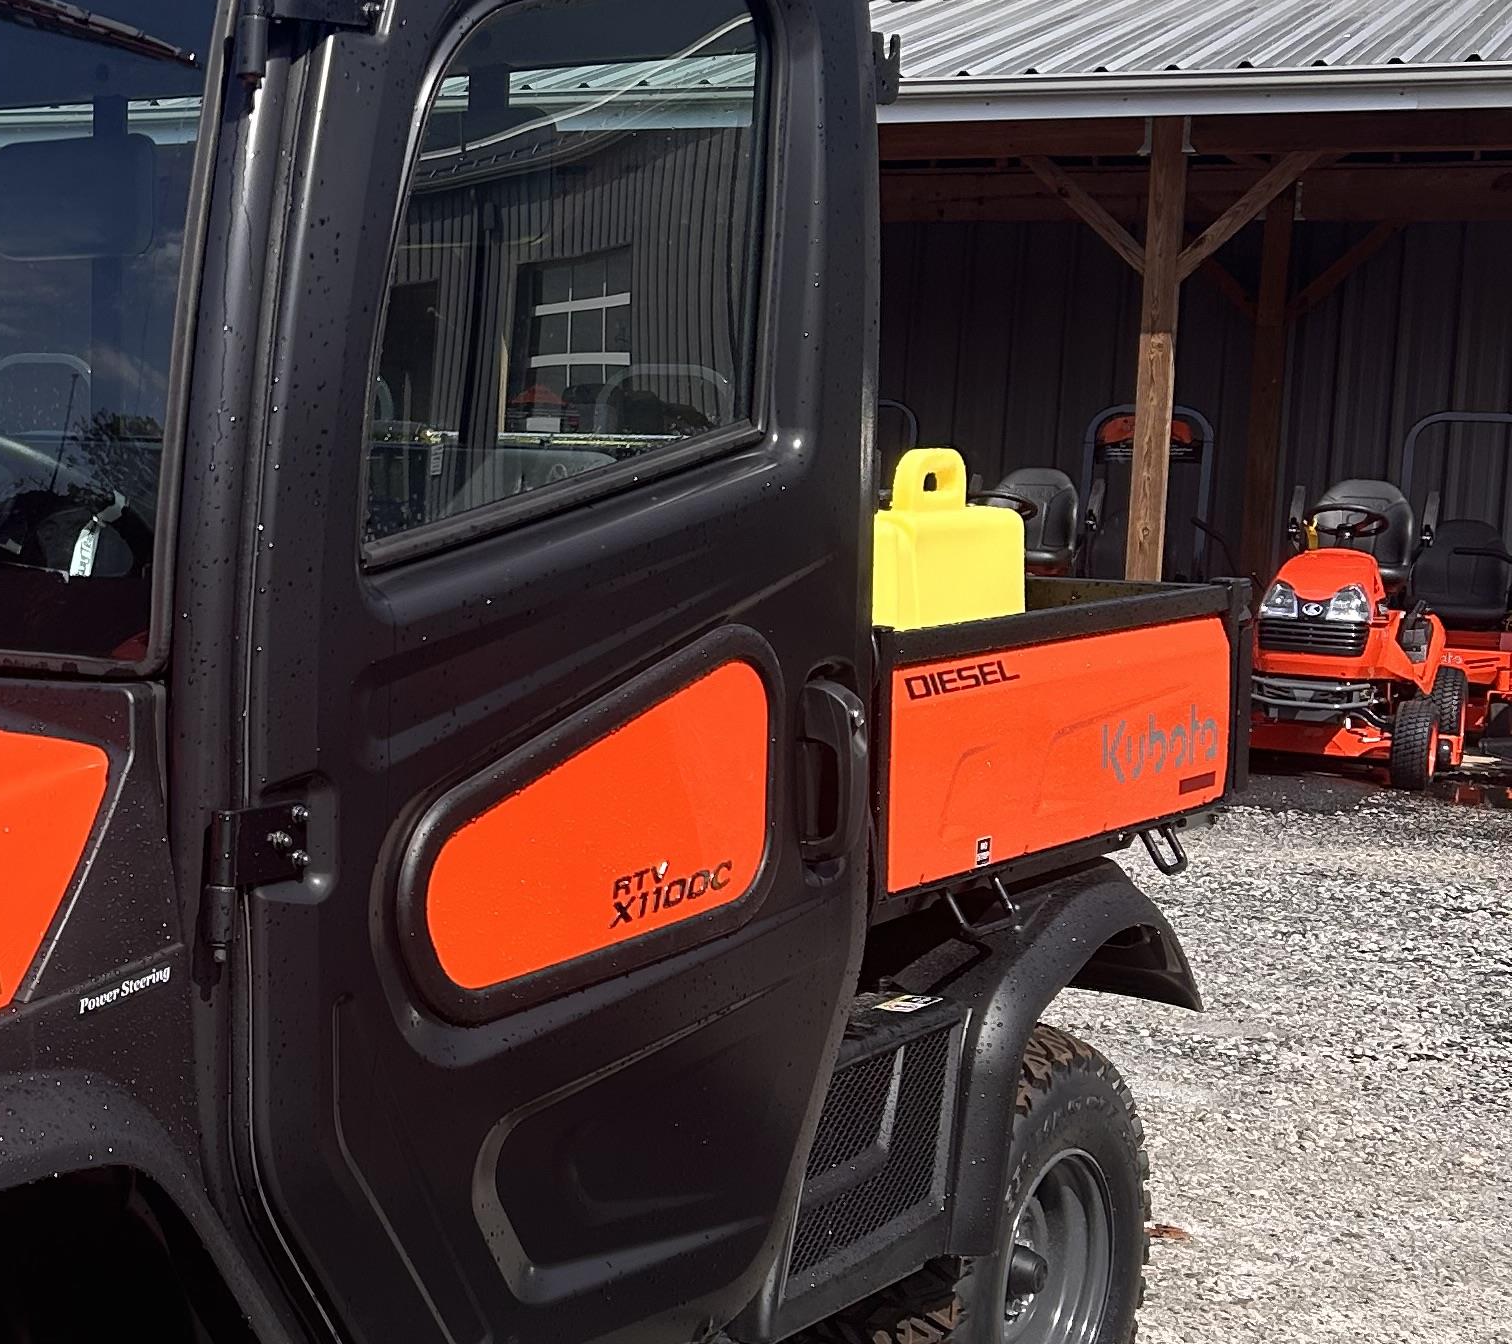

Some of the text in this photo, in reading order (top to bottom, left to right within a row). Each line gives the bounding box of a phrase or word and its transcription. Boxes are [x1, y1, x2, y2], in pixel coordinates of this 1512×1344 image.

[904, 660, 1020, 700] DIESEL
[1101, 704, 1218, 784] Kubota
[608, 860, 733, 929] X1100C
[613, 860, 670, 899] RTV
[79, 967, 171, 1014] Power Steering
